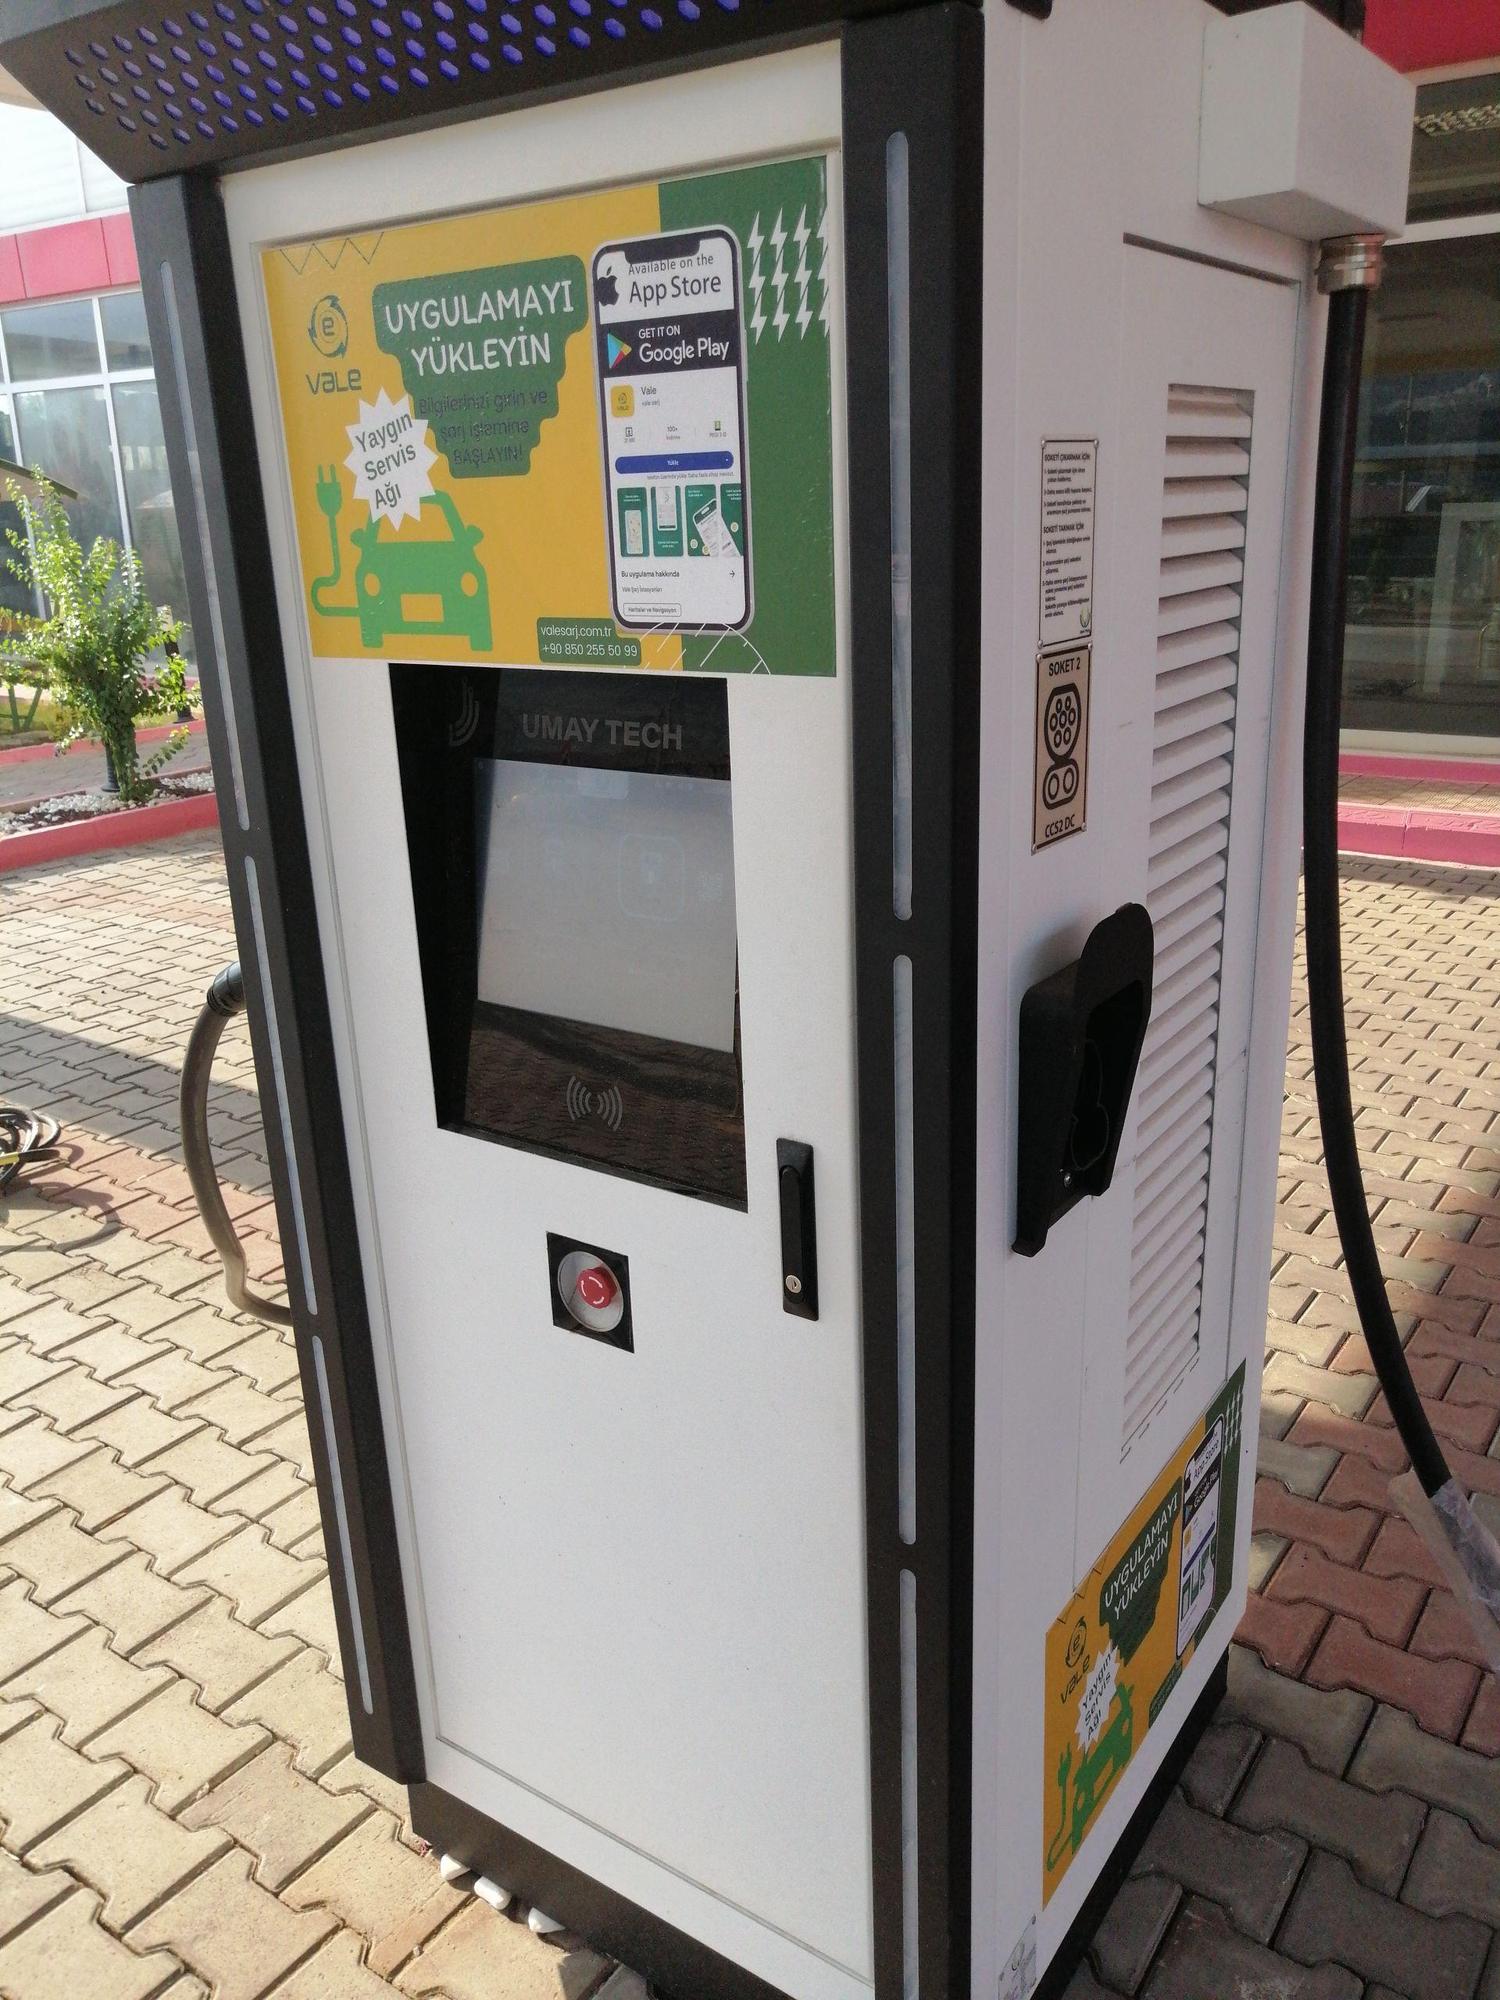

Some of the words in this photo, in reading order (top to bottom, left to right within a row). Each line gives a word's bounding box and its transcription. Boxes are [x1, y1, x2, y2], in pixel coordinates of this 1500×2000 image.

[628, 259, 676, 275] Available
[680, 259, 693, 269] on
[697, 253, 714, 266] the
[629, 281, 667, 307] App
[671, 275, 721, 298] Store
[385, 280, 574, 334] UYGULAMAYI
[638, 328, 656, 339] GET
[657, 327, 664, 337] IT
[666, 325, 680, 336] ON
[411, 326, 550, 376] YÜKLEYİN
[639, 340, 695, 365] Google
[697, 337, 729, 360] Play
[495, 389, 526, 413] girin
[530, 390, 547, 404] ve
[641, 386, 657, 395] Vale
[355, 413, 413, 452] Yaygın
[471, 420, 529, 441] işlemine
[364, 443, 417, 481] Servis
[374, 481, 402, 509] Ağı
[540, 625, 612, 639] valesarj.com.tr
[543, 643, 562, 655] +90
[565, 644, 584, 655] 850
[586, 644, 605, 656] 255
[608, 645, 621, 656] 50
[624, 645, 638, 657] 99
[1048, 658, 1075, 677] SOKET
[1076, 656, 1080, 670] 2
[522, 713, 600, 743] UMAY
[605, 719, 683, 750] TECH
[1044, 819, 1063, 838] CCS2
[1064, 814, 1075, 830] DC
[1104, 1492, 1179, 1608] UYGULAMAYI
[1114, 1531, 1169, 1621] YÜKLEYİN
[1083, 1654, 1111, 1709] Yaygın
